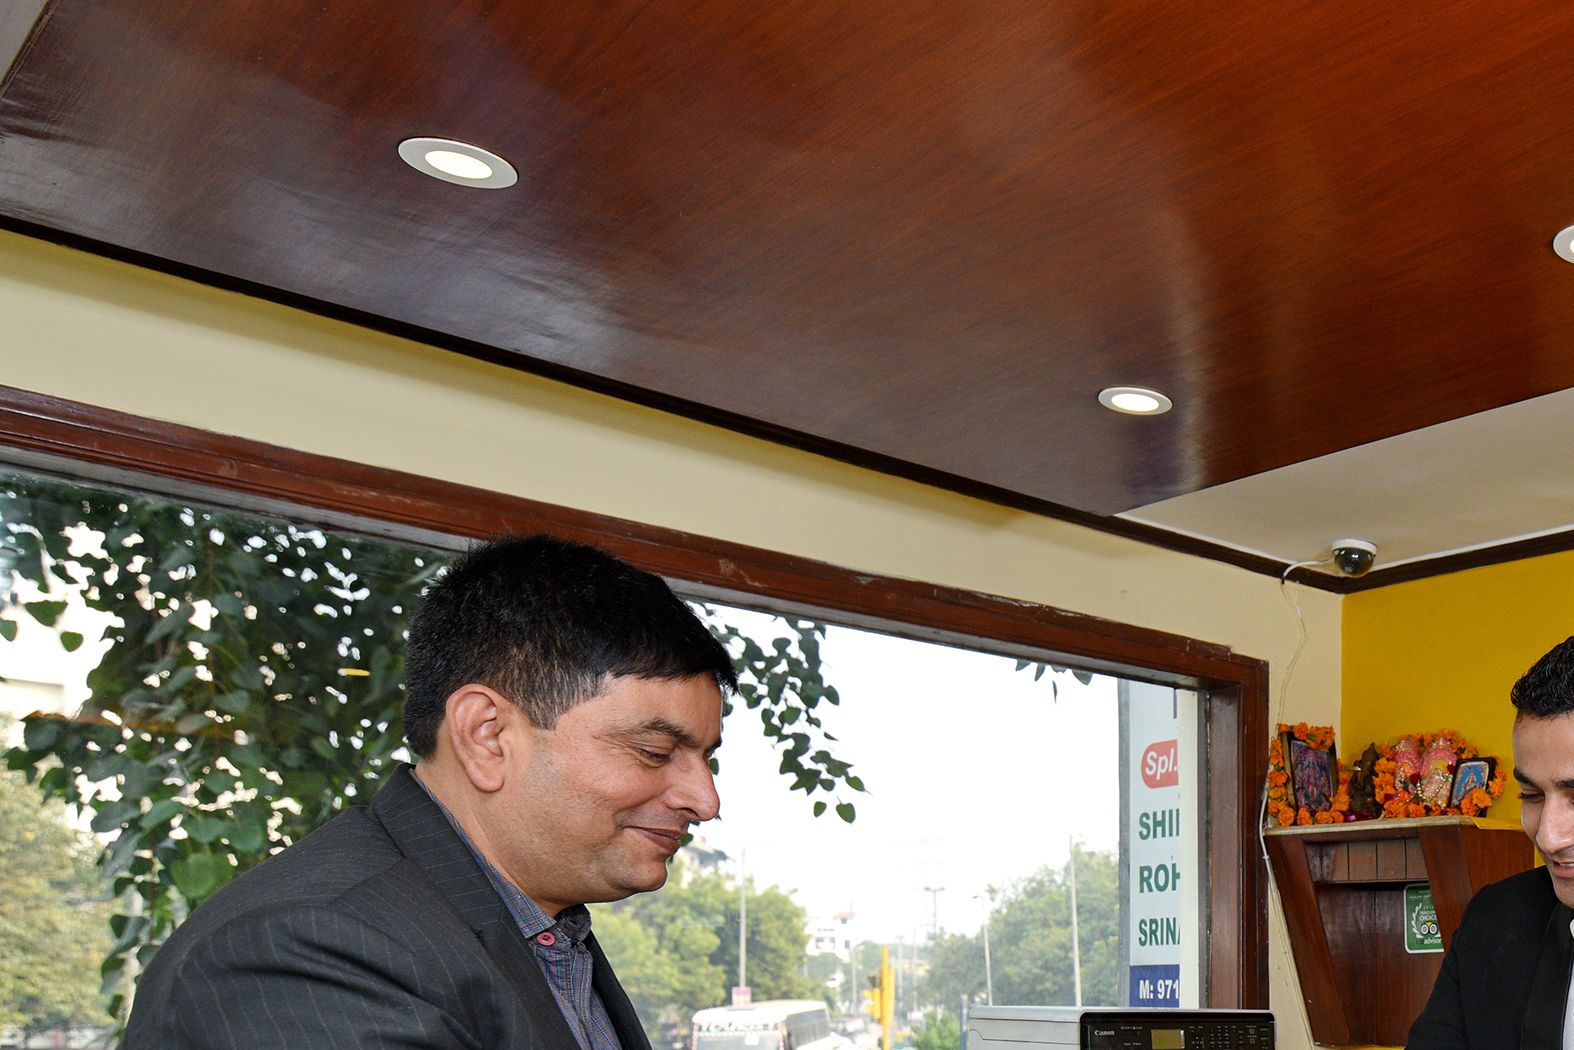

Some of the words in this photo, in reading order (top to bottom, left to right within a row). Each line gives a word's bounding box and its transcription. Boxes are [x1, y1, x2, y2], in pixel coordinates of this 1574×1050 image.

[1145, 748, 1178, 780] Spl.
[1138, 917, 1180, 947] SRIN
[1139, 980, 1153, 999] M:
